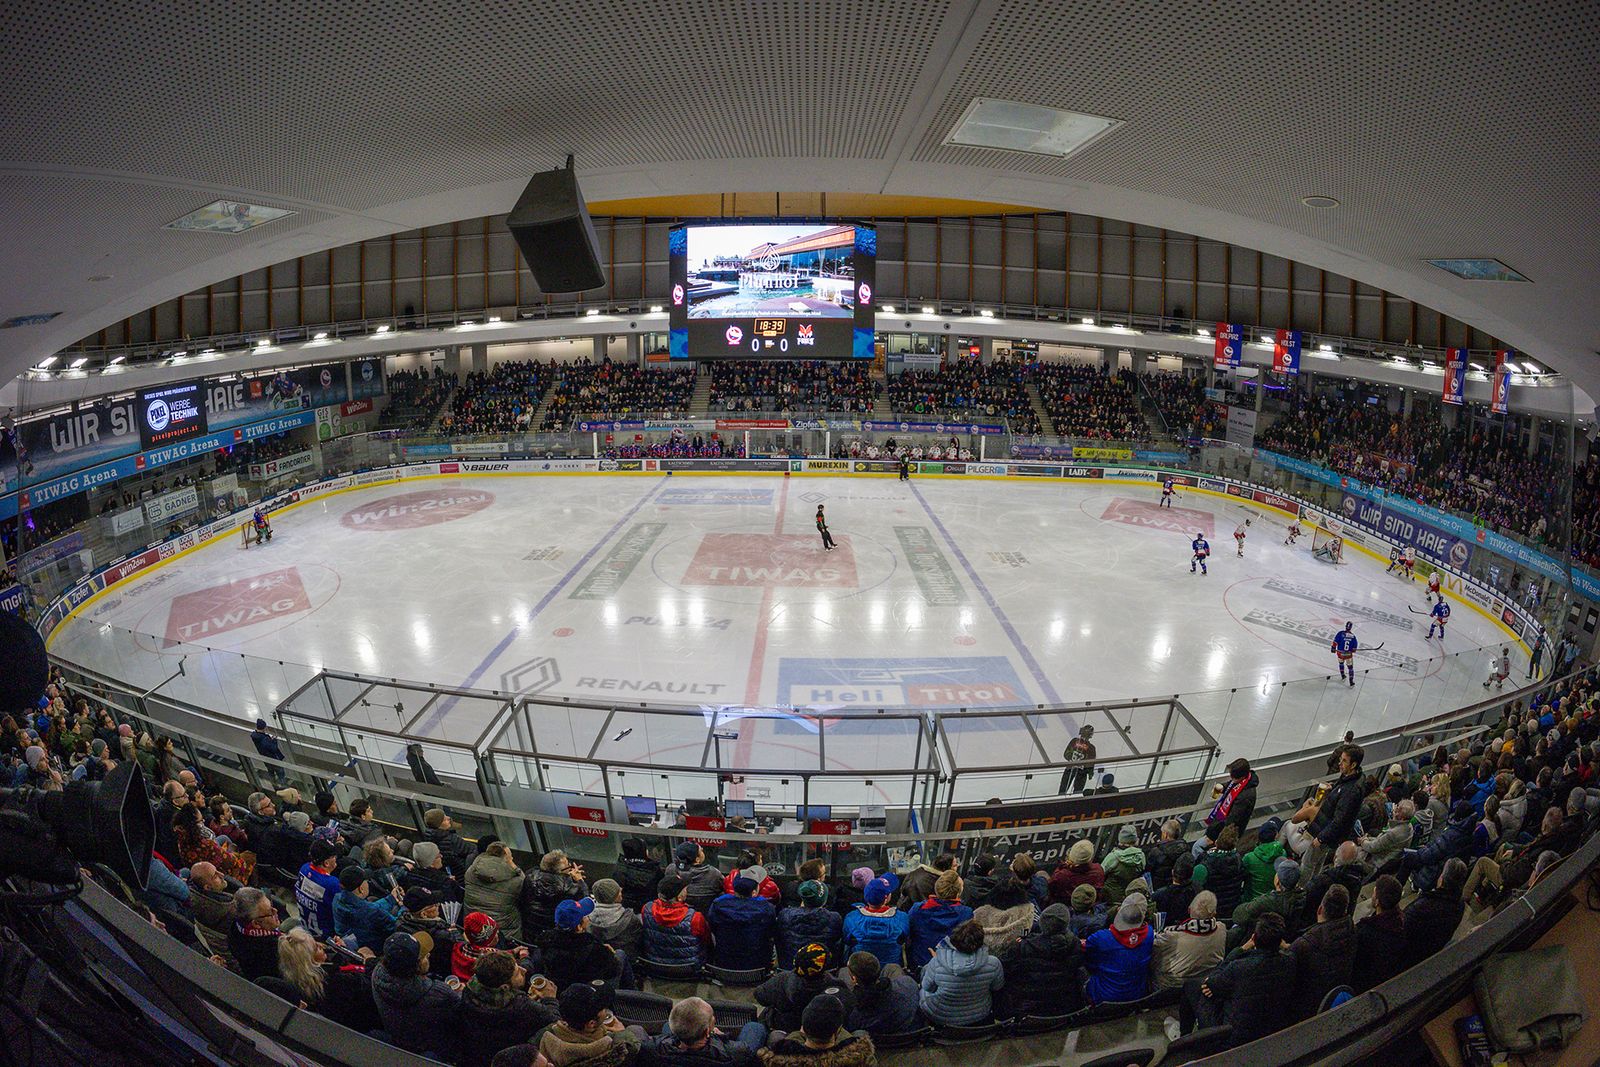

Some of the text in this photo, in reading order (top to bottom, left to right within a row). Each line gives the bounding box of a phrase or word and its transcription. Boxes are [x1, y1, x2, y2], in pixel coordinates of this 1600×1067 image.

[759, 321, 783, 330] 18:39
[751, 338, 788, 352] 0 0
[150, 405, 166, 421] PIXEL
[170, 399, 190, 411] WERBE
[171, 407, 198, 420] TECHNIK
[50, 404, 136, 453] WIR SI
[246, 417, 302, 437] TIWAG Arena
[150, 437, 220, 465] TIWAG Arena
[34, 468, 118, 502] TIWAG Arena
[164, 493, 197, 512] GADNER
[1418, 507, 1438, 522] Partner
[1451, 521, 1462, 532] Ort
[1360, 505, 1382, 524] WIR
[1384, 515, 1414, 540] SIND
[1417, 527, 1448, 555] HAIE
[1490, 536, 1513, 553] TIWAG
[704, 566, 840, 582] TIWAG
[72, 585, 89, 604] Zipfer
[1464, 584, 1492, 604] McDonald's
[179, 598, 295, 638] TIWAG
[624, 616, 688, 627] PUS
[1344, 641, 1350, 651] 6
[576, 676, 727, 696] RENAULT
[810, 686, 1005, 702] Heli Tirol
[576, 826, 605, 836] TIWAG
